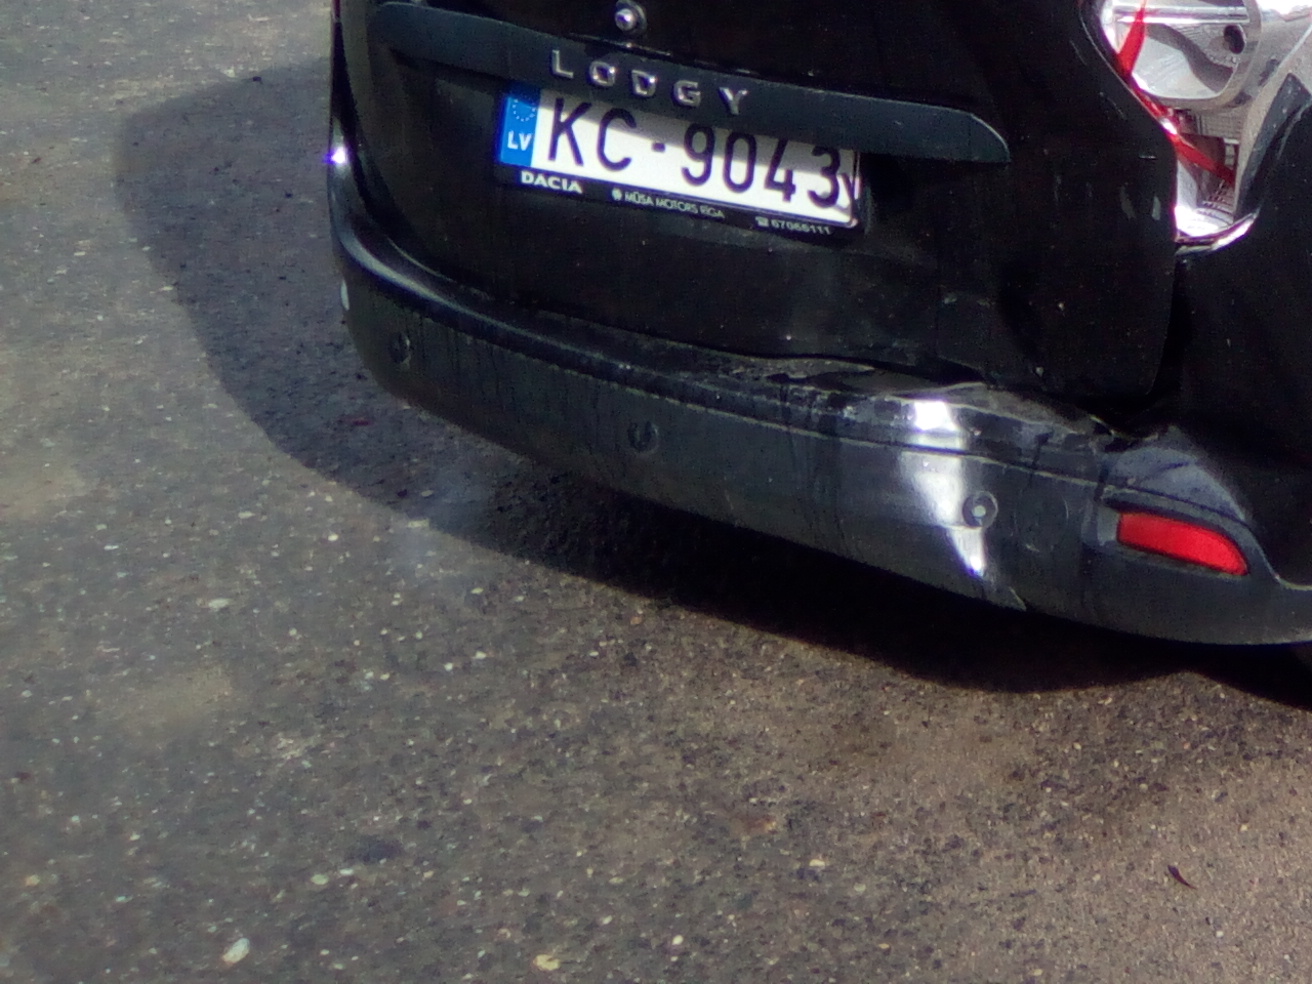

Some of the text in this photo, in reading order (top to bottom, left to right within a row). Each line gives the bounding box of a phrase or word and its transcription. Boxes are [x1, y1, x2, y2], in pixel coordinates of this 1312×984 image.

[551, 49, 748, 116] LODGY
[507, 129, 532, 153] LV
[520, 170, 583, 194] DACIA
